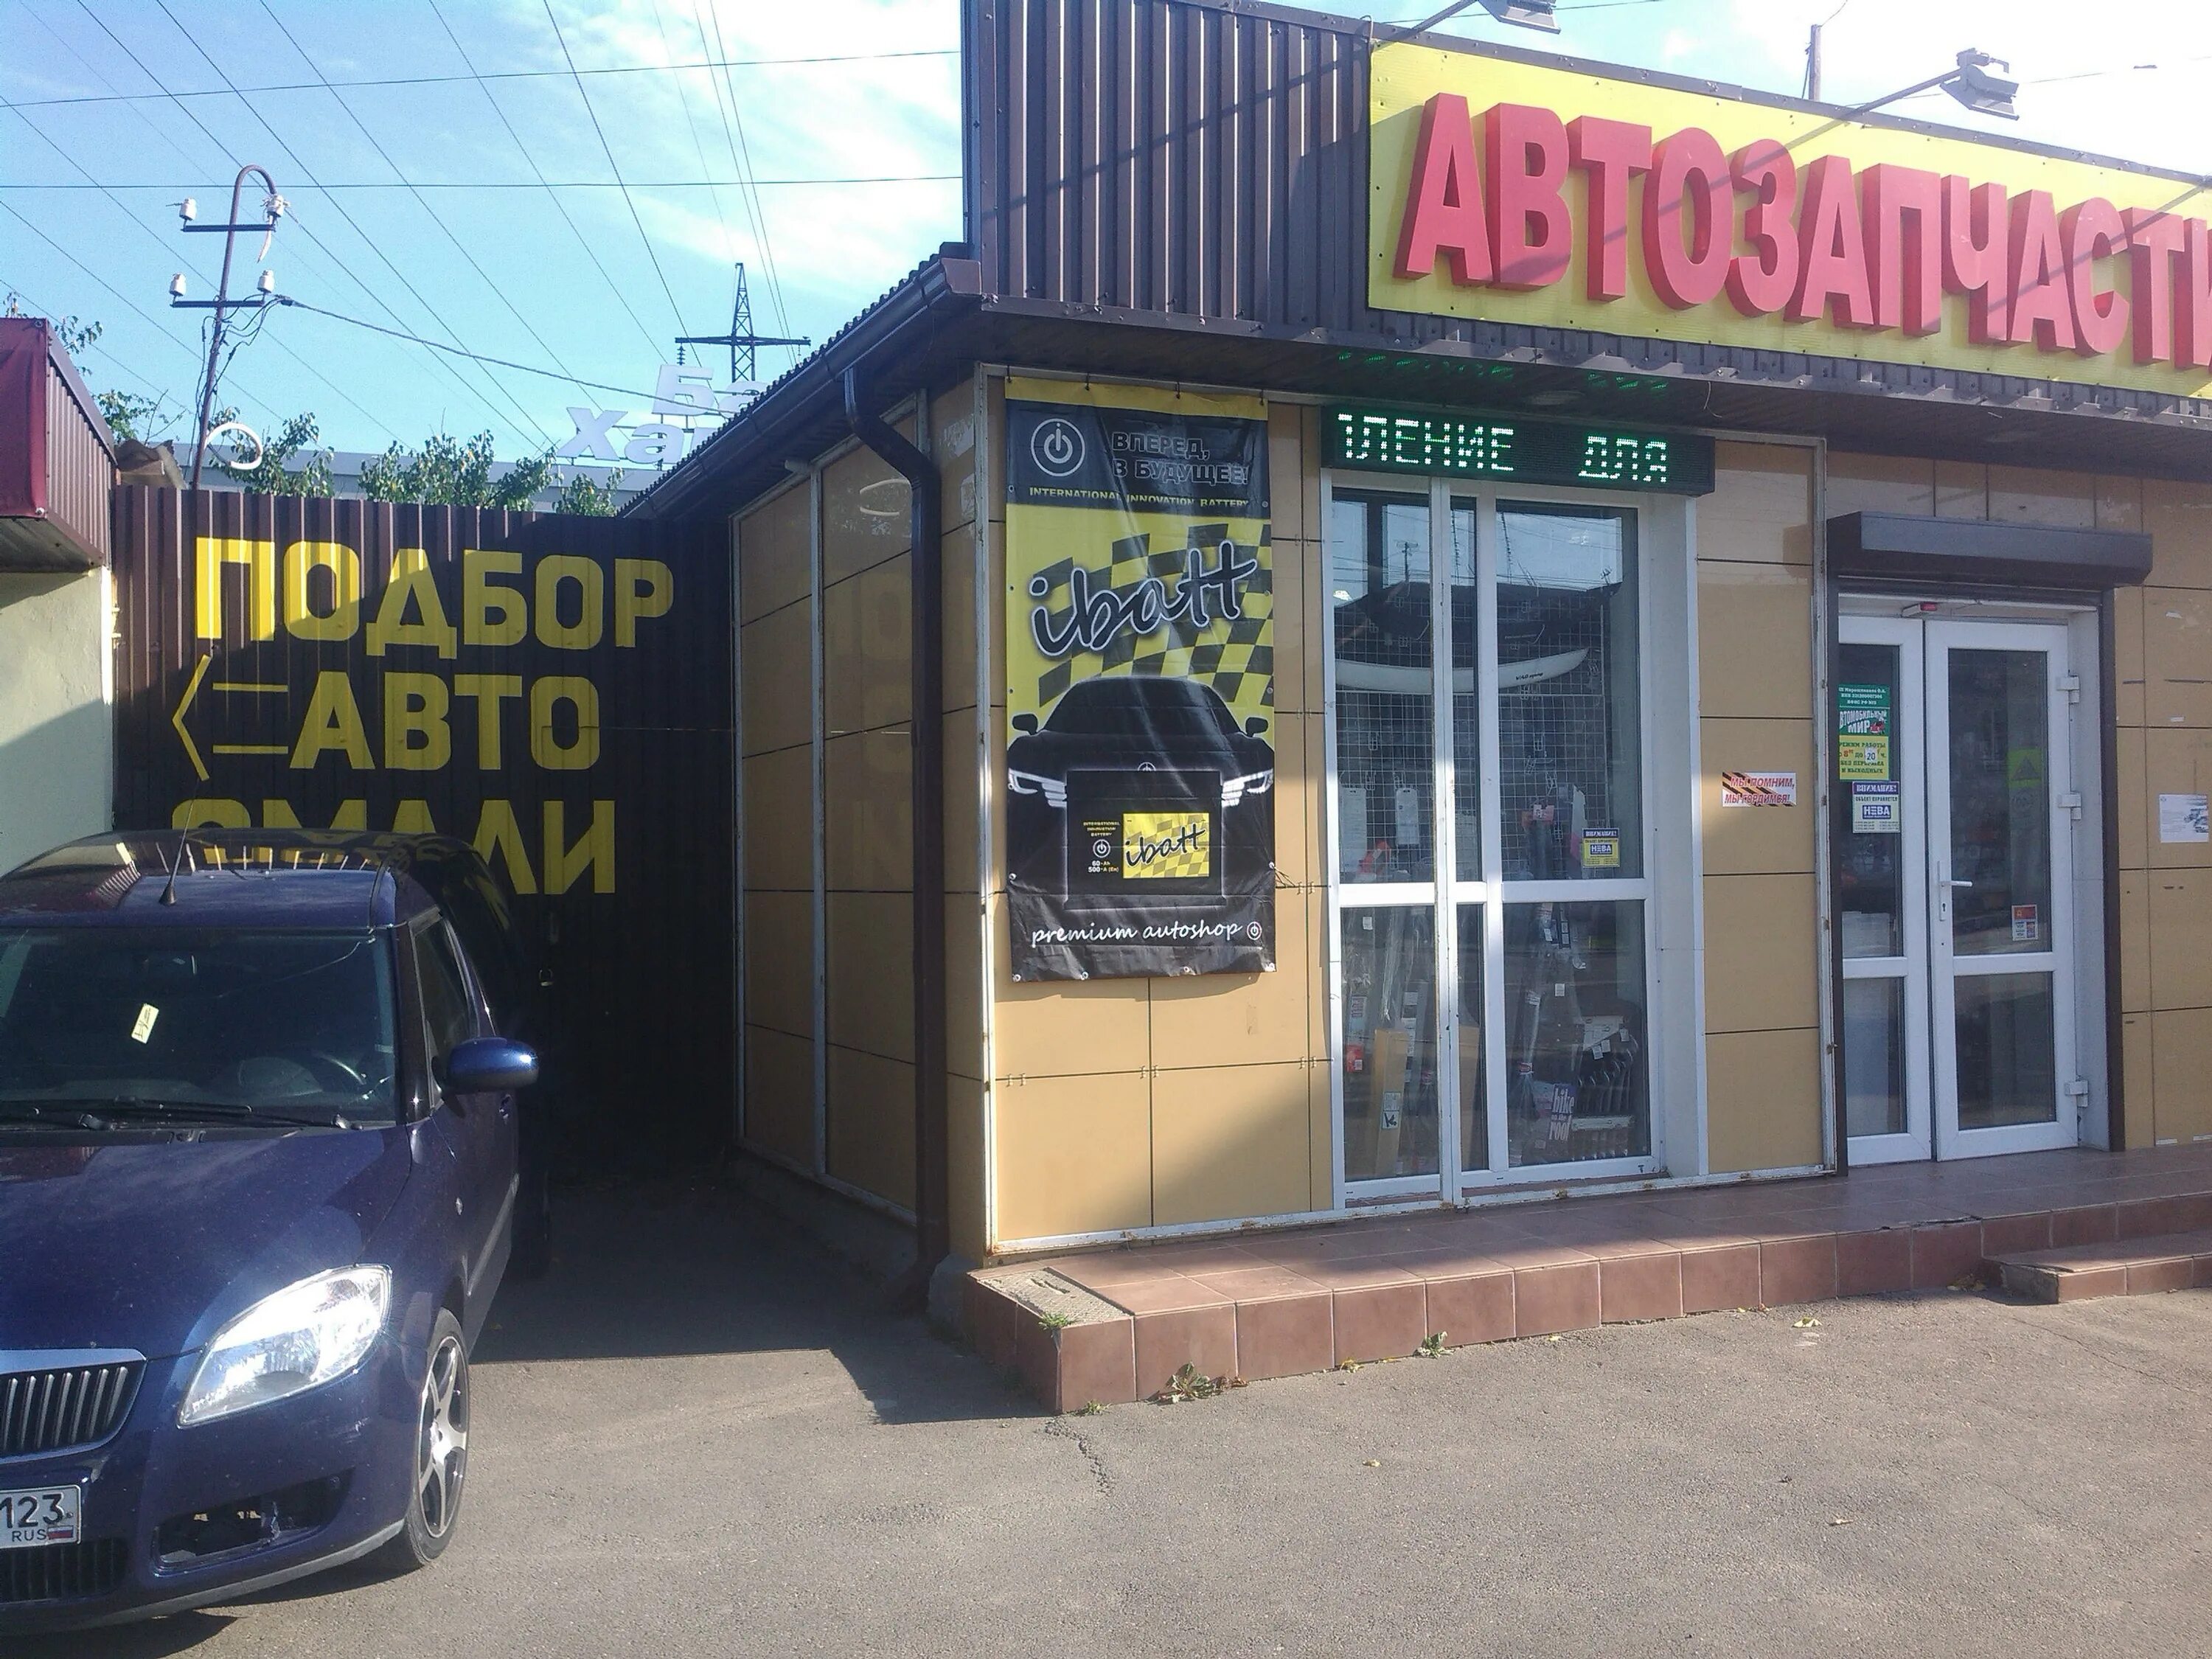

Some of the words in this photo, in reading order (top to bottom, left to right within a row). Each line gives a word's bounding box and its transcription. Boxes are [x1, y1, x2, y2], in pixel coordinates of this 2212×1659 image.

[556, 406, 717, 465] Ха
[1111, 431, 1210, 460] ВПЕРЕД,
[1135, 459, 1251, 487] БУДУЩЕЕ!
[1578, 435, 1667, 483] ДЛЯ
[1126, 493, 1195, 505] INNOVATION
[1200, 498, 1250, 508] BATTERY
[195, 536, 675, 659] ПОДБОР
[1029, 540, 1258, 656] ibatt
[289, 671, 600, 771] АВТО
[1840, 710, 1887, 729] ВТОМОБИЛЬНЫЙ
[1848, 720, 1871, 733] МИР
[1867, 752, 1876, 760] 20
[1750, 777, 1795, 789] ПОМНИМ,
[1863, 806, 1891, 815] НЕВА
[1125, 823, 1206, 867] ibatt
[1032, 922, 1138, 948] premium
[1142, 919, 1243, 941] autoshop
[0, 1492, 66, 1529] 123
[11, 1528, 47, 1542] RUS
